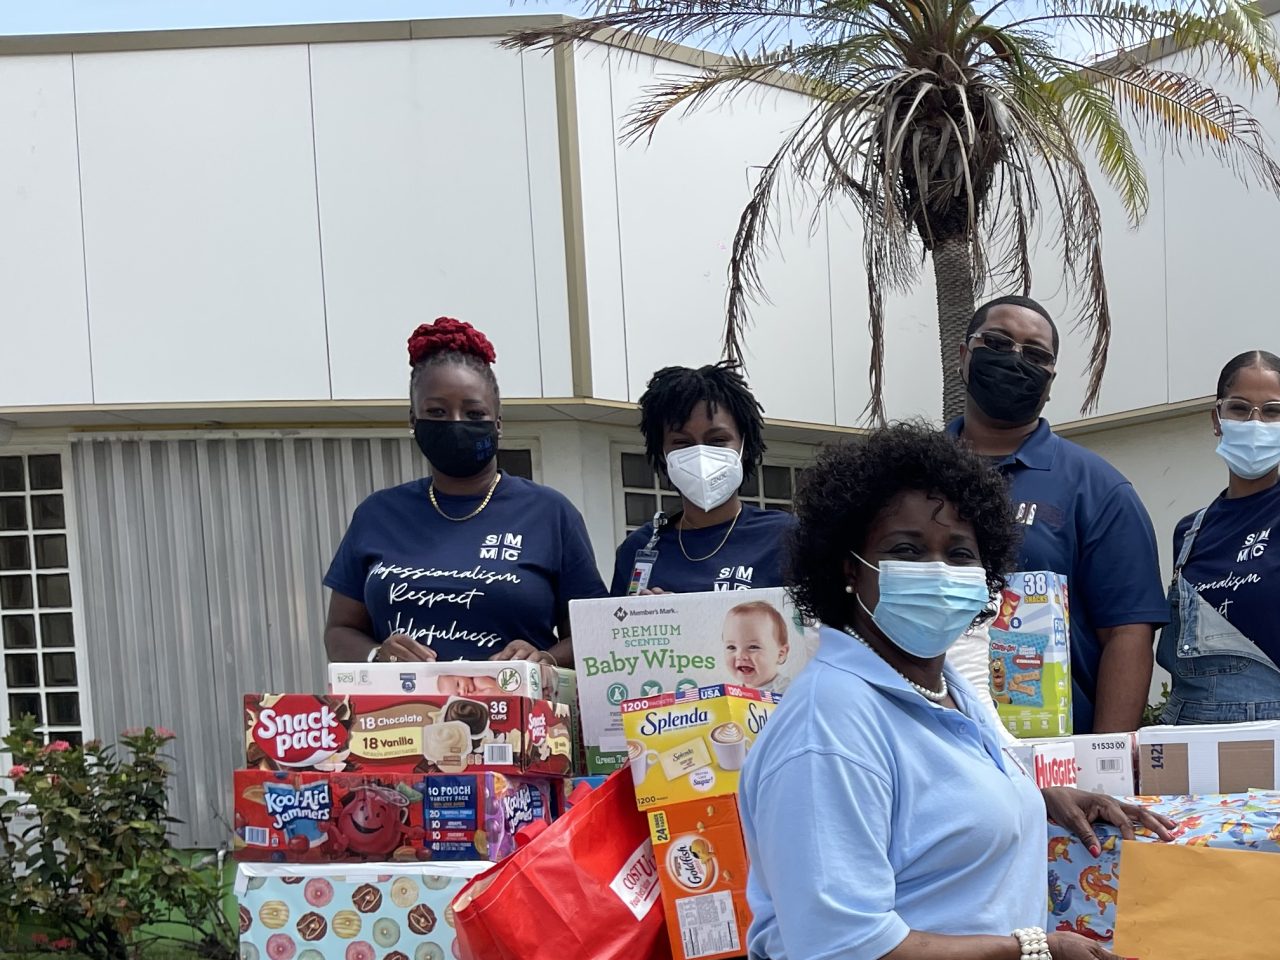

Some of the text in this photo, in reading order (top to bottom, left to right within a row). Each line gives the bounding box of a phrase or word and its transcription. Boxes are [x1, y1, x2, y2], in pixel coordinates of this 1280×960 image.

[1024, 572, 1047, 597] 38
[389, 582, 485, 609] Respect
[630, 608, 659, 616] Member's
[612, 624, 681, 640] PREMIUM
[625, 638, 670, 648] SCENTED
[582, 649, 716, 677] Baby Wipes
[490, 701, 507, 714] 36
[623, 700, 649, 712] 1200
[701, 689, 720, 699] USA
[258, 706, 339, 739] Snack
[360, 715, 422, 730] 18 Chocolate
[641, 707, 708, 736] Splenda
[276, 728, 340, 757] pack
[363, 737, 414, 750] 18 Vanilla
[1092, 742, 1115, 750] 51533
[1034, 753, 1077, 789] HUGGIES
[441, 786, 471, 796] POUCH
[265, 785, 330, 813] Kool-Aid
[637, 796, 656, 805] 1200
[272, 807, 330, 829] Jammers
[429, 810, 440, 818] 20
[432, 820, 441, 829] 10
[432, 831, 441, 840] 10
[657, 828, 668, 842] 24
[677, 845, 702, 885] Goldfish
